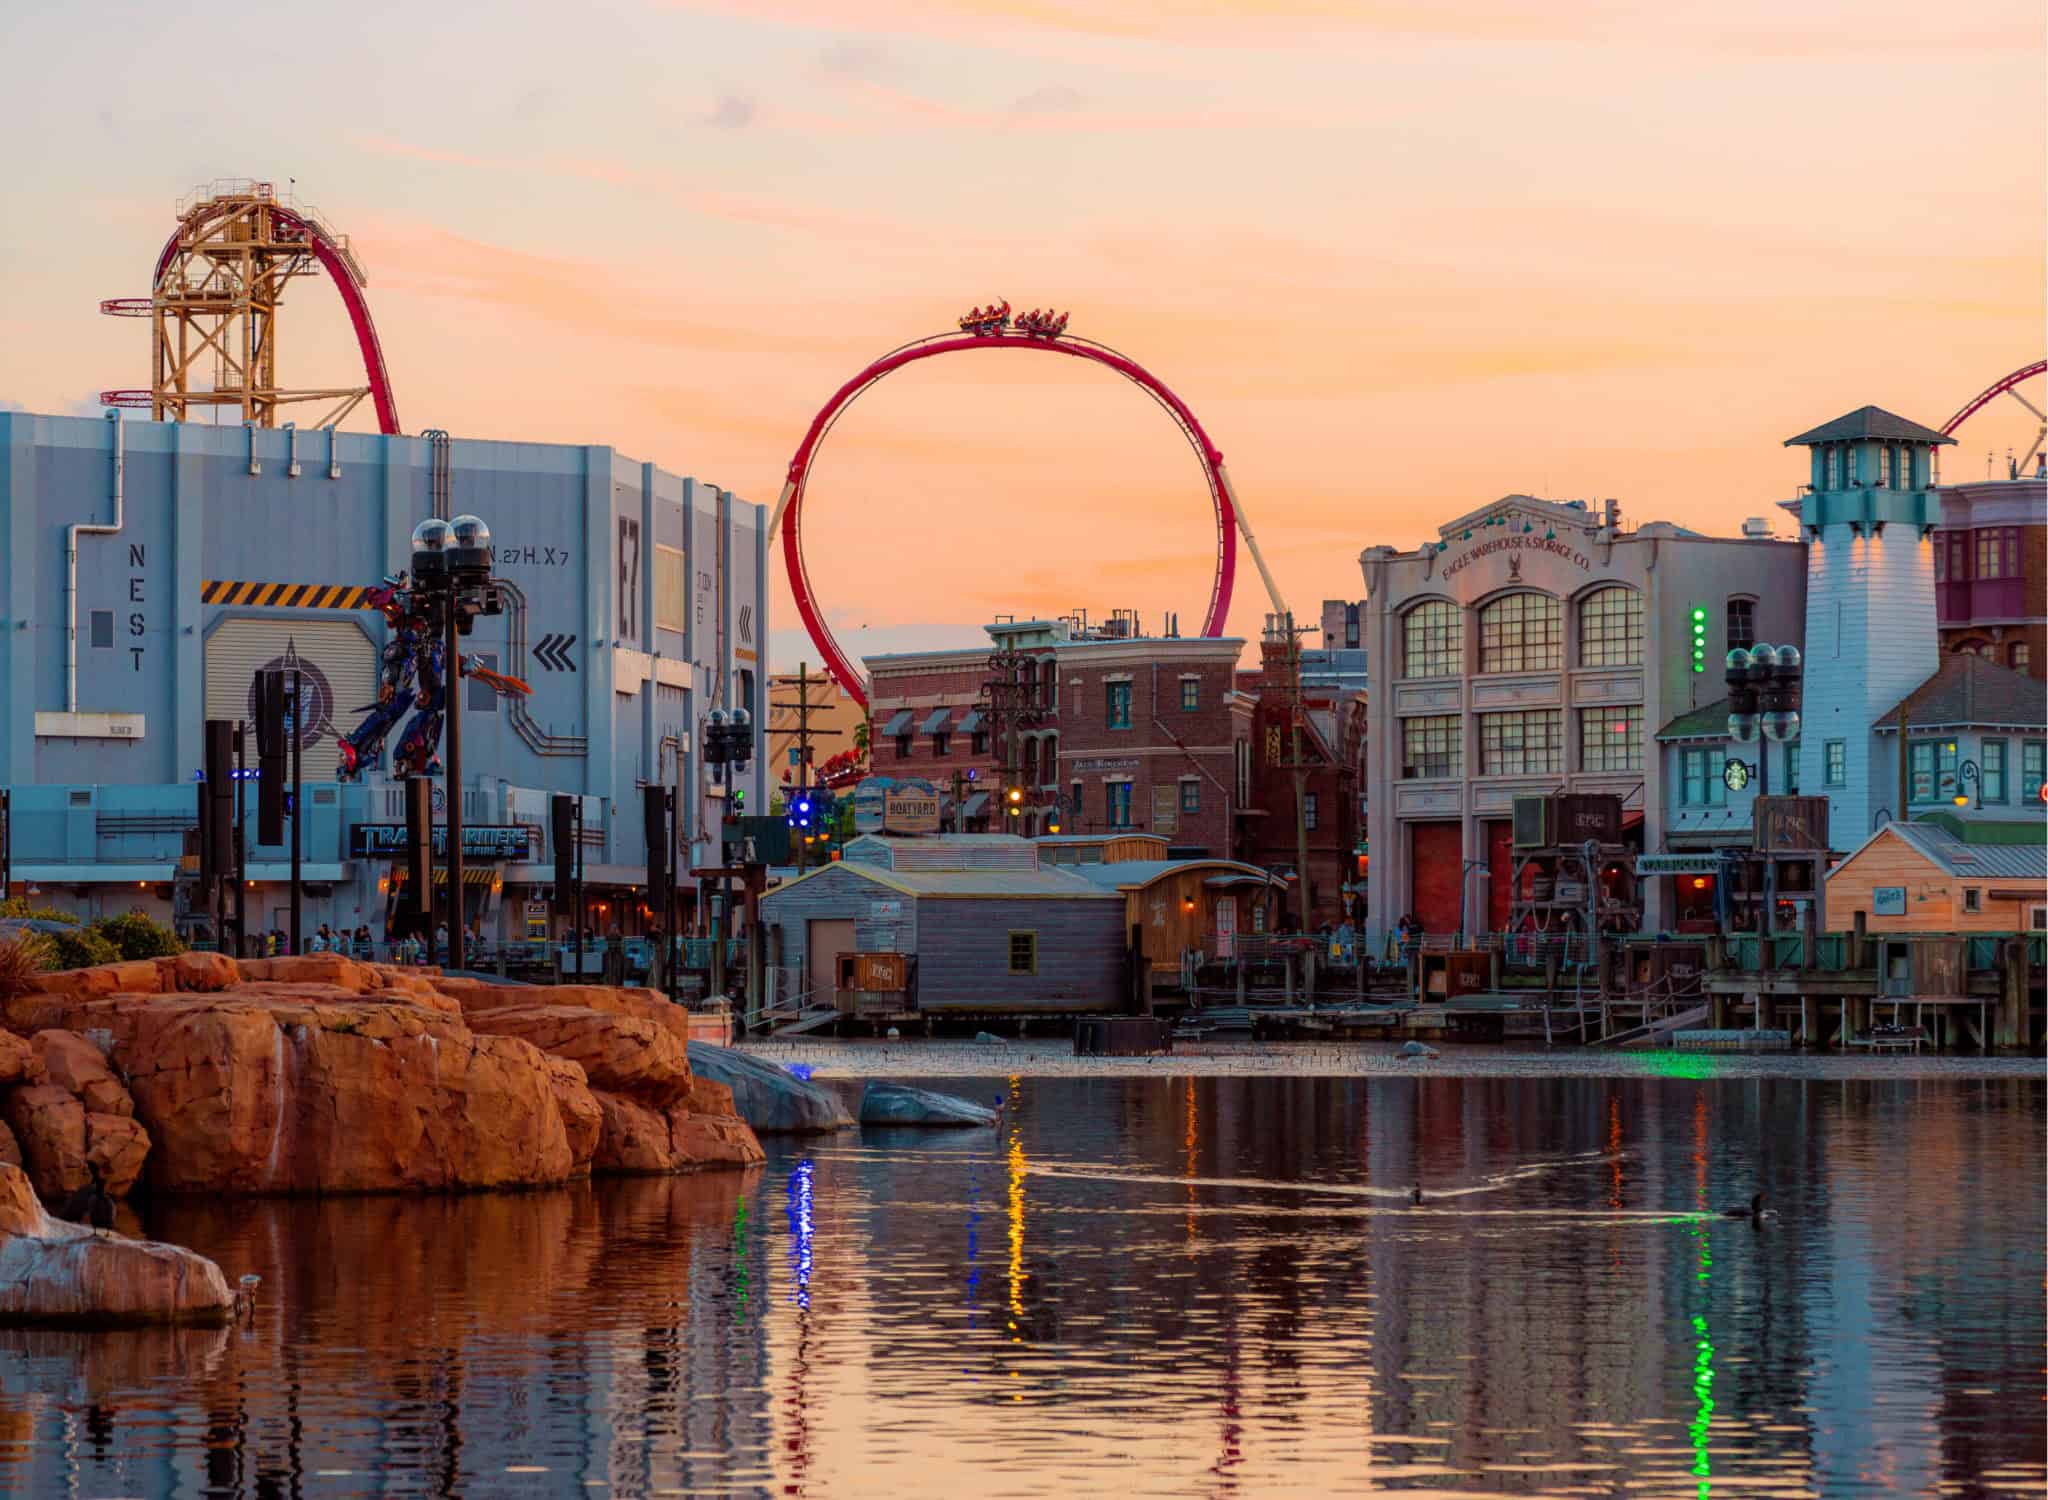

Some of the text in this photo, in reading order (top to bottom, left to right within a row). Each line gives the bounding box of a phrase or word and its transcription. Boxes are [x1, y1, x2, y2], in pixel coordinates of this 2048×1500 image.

[1442, 551, 1471, 581] EAGLE
[1471, 537, 1524, 561] WAREHOUSE
[1525, 537, 1532, 548] &
[1532, 537, 1572, 561] STORAGE
[129, 544, 145, 672] NEST
[890, 801, 936, 815] BOATYARD
